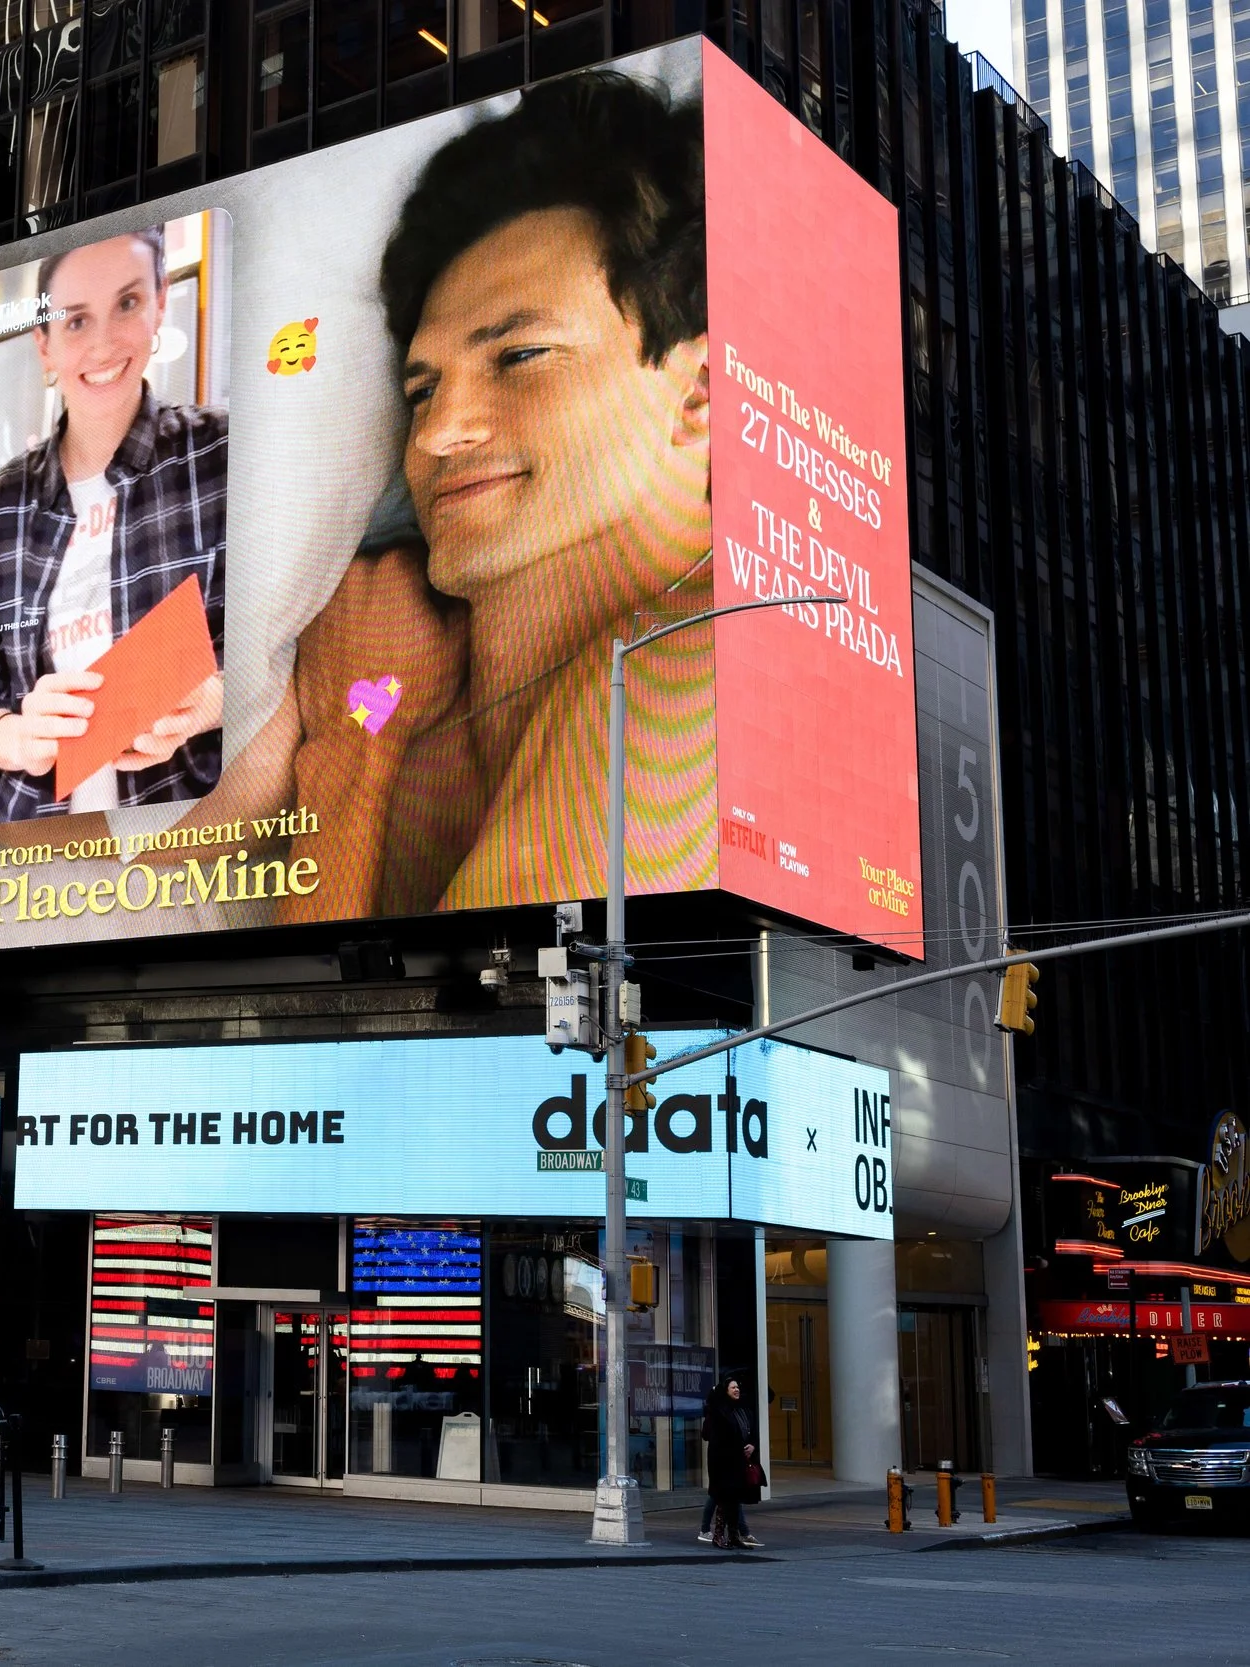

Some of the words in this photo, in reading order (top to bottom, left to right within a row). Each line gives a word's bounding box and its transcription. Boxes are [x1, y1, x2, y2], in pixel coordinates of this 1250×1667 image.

[724, 342, 774, 407] From
[777, 381, 811, 431] The
[813, 405, 867, 470] Writer
[870, 450, 893, 487] Of
[740, 401, 770, 453] 27
[776, 423, 881, 530] DRESSES
[808, 497, 822, 533] &
[752, 499, 804, 572] THE
[809, 536, 879, 616] DEVIL
[726, 536, 819, 631] WEARS
[825, 598, 904, 678] PRADA
[4, 622, 19, 632] THIS
[20, 618, 39, 629] CARD
[732, 805, 748, 820] ONLY
[747, 813, 756, 823] ON
[0, 837, 122, 868] rom-com
[128, 819, 245, 853] moment
[251, 804, 320, 839] with
[722, 818, 767, 861] NETFLIX
[779, 841, 797, 858] NOW
[780, 858, 810, 878] PLAYING
[858, 856, 885, 885] Your
[886, 867, 915, 897] Place
[868, 888, 880, 906] or
[881, 889, 909, 916] Mine
[17, 1114, 60, 1146] RT
[69, 1113, 139, 1146] FOR
[148, 1112, 222, 1145] THE
[233, 1110, 345, 1145] HOME
[540, 1153, 599, 1169] BROADWAY
[631, 1181, 640, 1198] 43
[855, 1153, 893, 1215] OB
[1118, 1181, 1170, 1206] Brooklyn
[1134, 1198, 1167, 1215] Diner
[1130, 1220, 1161, 1242] Cafe
[1149, 1311, 1223, 1328] DIER
[1177, 1337, 1202, 1348] RAISE
[1181, 1350, 1202, 1360] PLOW
[95, 1377, 117, 1385] CBRE
[146, 1367, 206, 1391] BROADWAY
